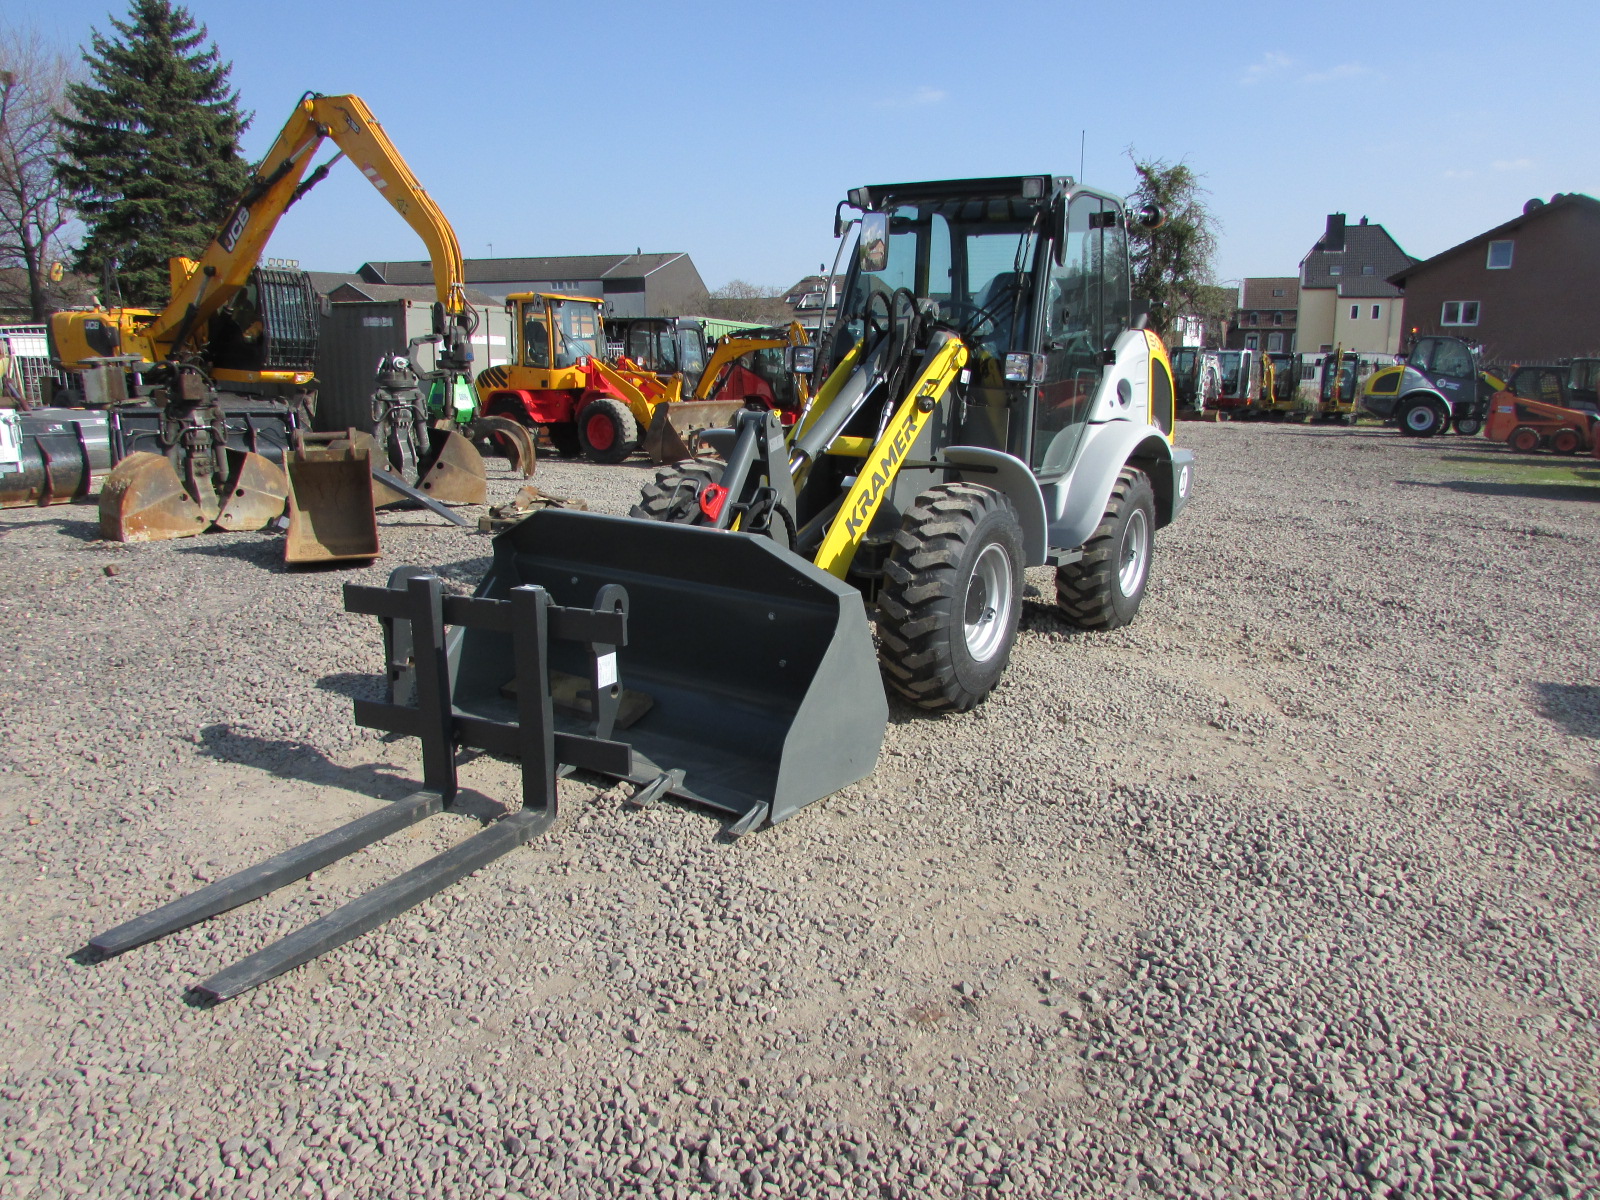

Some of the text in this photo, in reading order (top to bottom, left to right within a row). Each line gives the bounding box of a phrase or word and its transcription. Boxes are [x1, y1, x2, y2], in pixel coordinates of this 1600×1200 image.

[227, 206, 250, 252] JCB
[85, 321, 100, 330] JCB
[844, 414, 918, 539] KRAMER
